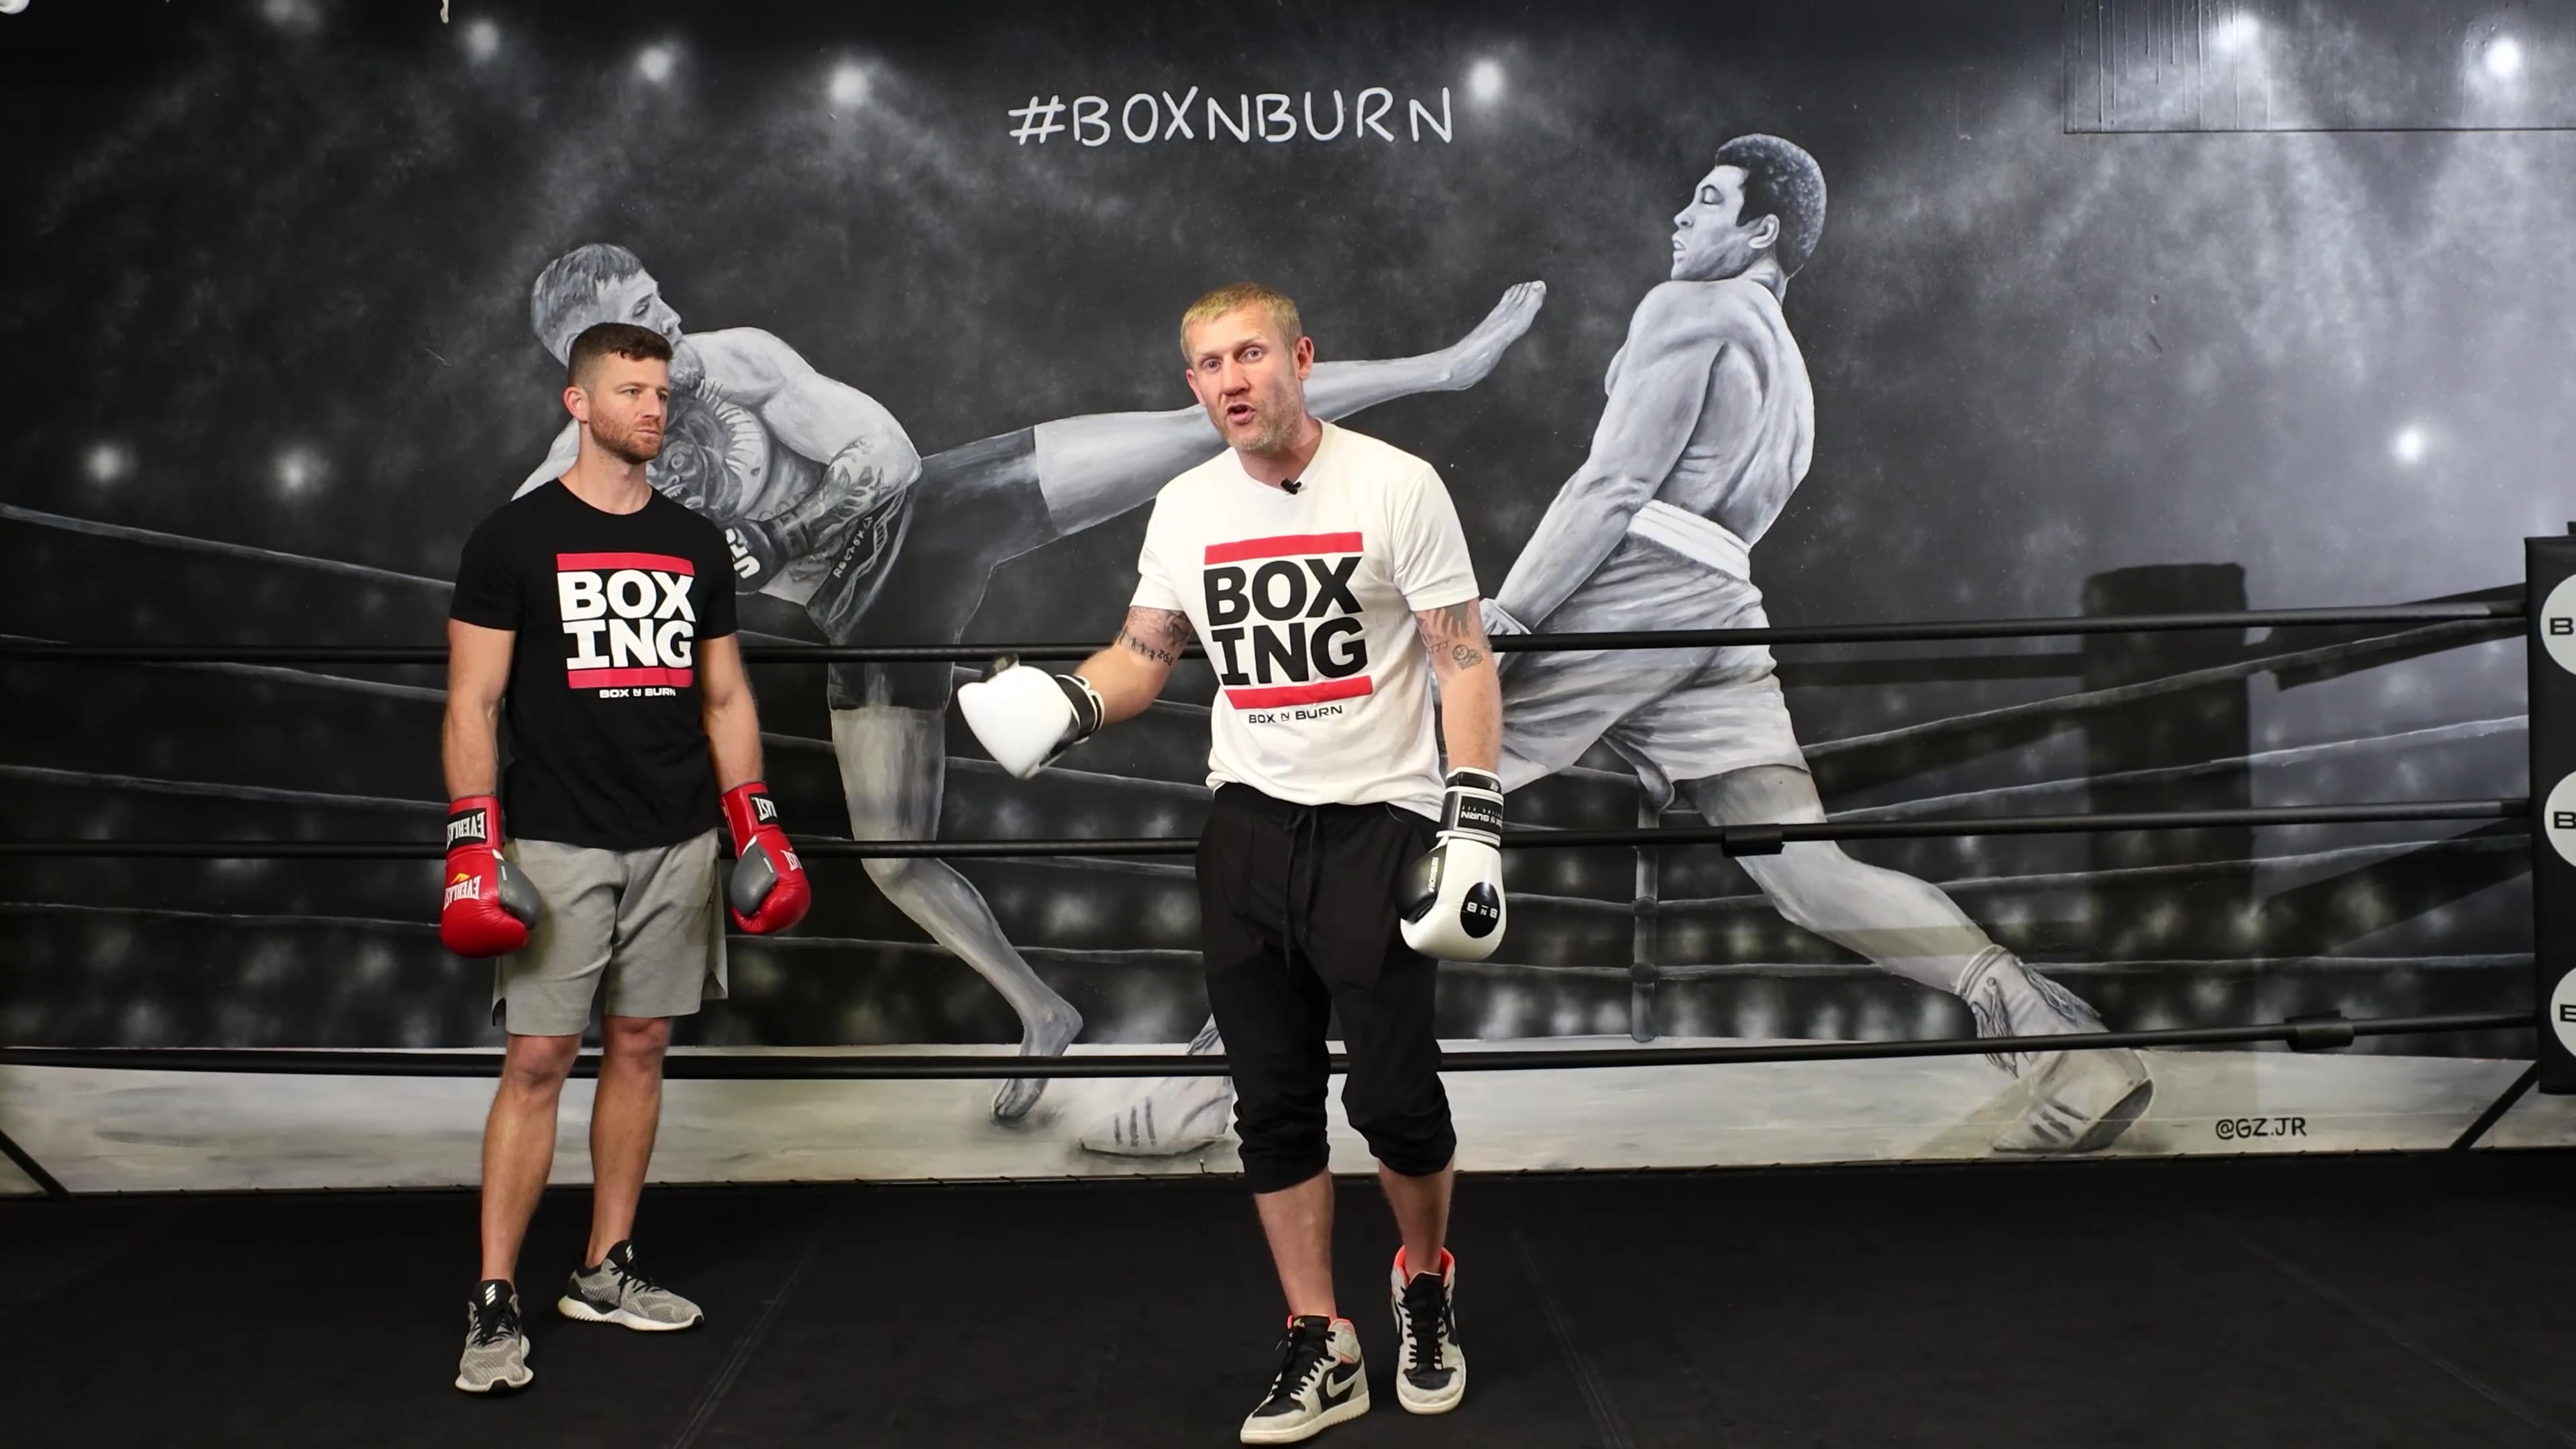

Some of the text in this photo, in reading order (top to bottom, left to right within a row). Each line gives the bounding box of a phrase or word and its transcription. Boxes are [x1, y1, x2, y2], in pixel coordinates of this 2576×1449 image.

[1008, 86, 1453, 147] #BOXNBURN
[557, 570, 696, 622] BOX
[1203, 556, 1363, 627] BOX
[562, 620, 694, 669] ING
[1211, 616, 1368, 686] ING
[599, 689, 629, 698] BOX
[645, 688, 676, 696] BURN
[1248, 705, 1343, 724] BOX N BURN
[445, 812, 486, 850] EVERLAS
[1460, 811, 1490, 822] BURN
[443, 875, 482, 911] EVERLAS
[2216, 1117, 2307, 1140] @GZ.JR
